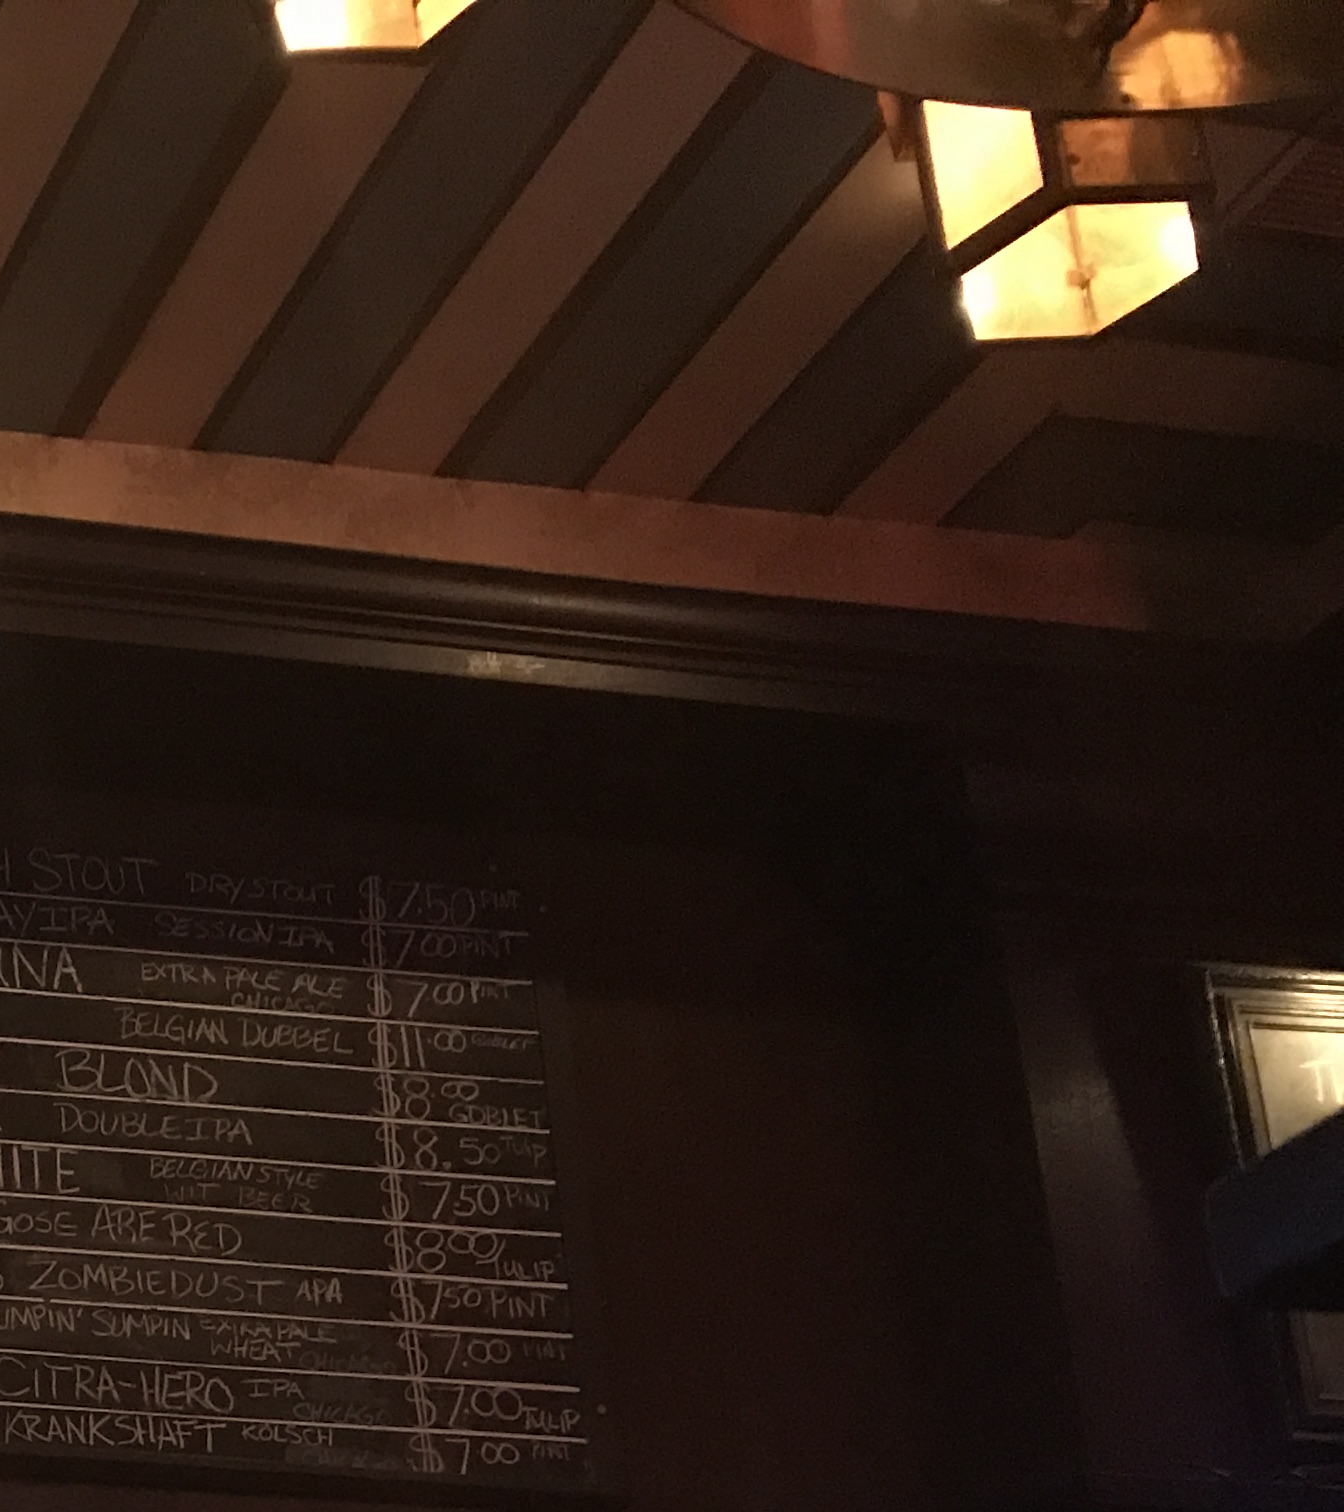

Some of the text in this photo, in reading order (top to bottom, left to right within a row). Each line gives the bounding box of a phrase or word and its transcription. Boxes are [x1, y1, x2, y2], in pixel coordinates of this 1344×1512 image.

[28, 847, 157, 895] STOUT
[249, 877, 335, 904] STOUT
[40, 907, 114, 935] IPA
[280, 926, 335, 954] IPA
[225, 967, 281, 991] PALE
[293, 972, 346, 999] ALE
[114, 1006, 228, 1045] BELGIAN
[240, 1018, 353, 1054] DUBBEL
[56, 1049, 218, 1102] BLOND
[186, 1116, 252, 1145] IPA
[150, 1157, 253, 1180] BELGIAN
[92, 1204, 157, 1243] ARE
[164, 1211, 242, 1256] RED
[297, 1278, 343, 1306] APA
[483, 1288, 555, 1318] PINT
[92, 1310, 190, 1340] SUMPIN
[212, 1338, 301, 1364] WHEAT
[242, 1379, 304, 1399] IPA
[5, 1411, 226, 1453] KRANKSHAFT
